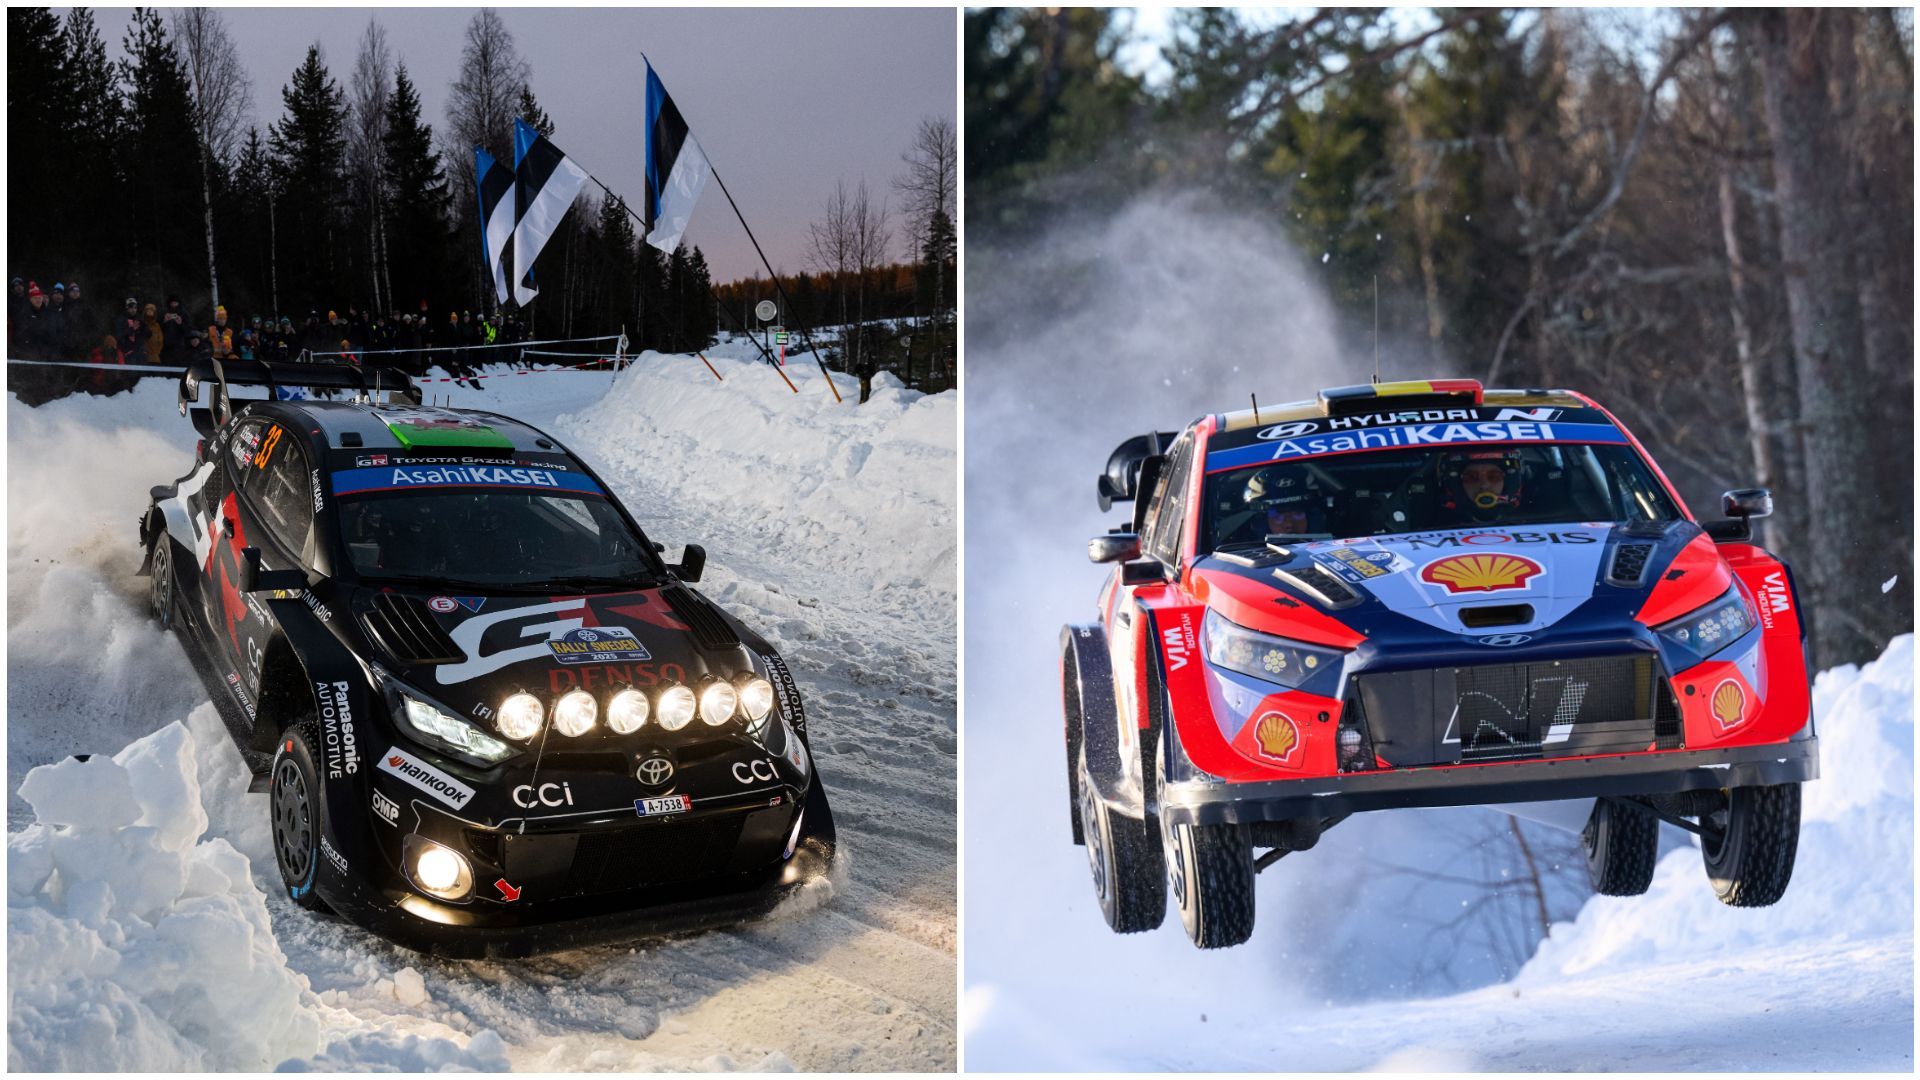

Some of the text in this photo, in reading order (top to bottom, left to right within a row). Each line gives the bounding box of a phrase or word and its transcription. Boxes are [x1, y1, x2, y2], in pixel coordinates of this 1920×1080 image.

[1329, 408, 1479, 429] HYUNDAI
[254, 424, 283, 469] 33
[1271, 422, 1555, 460] AsahiKASEI
[358, 457, 388, 467] GR
[392, 456, 458, 465] TOYOTA
[311, 468, 324, 513] AsahiKASEI
[392, 466, 559, 487] AsahiKASEI
[1408, 532, 1597, 550] MOBIS
[301, 587, 332, 623] TAMADIC
[551, 638, 640, 653] RALLY SWEDEN
[548, 663, 687, 694] DENSO
[316, 681, 342, 779] AUTOMOTIVE
[332, 680, 360, 775] Panasonic
[372, 793, 400, 821] OMP
[648, 798, 683, 813] A-7538
